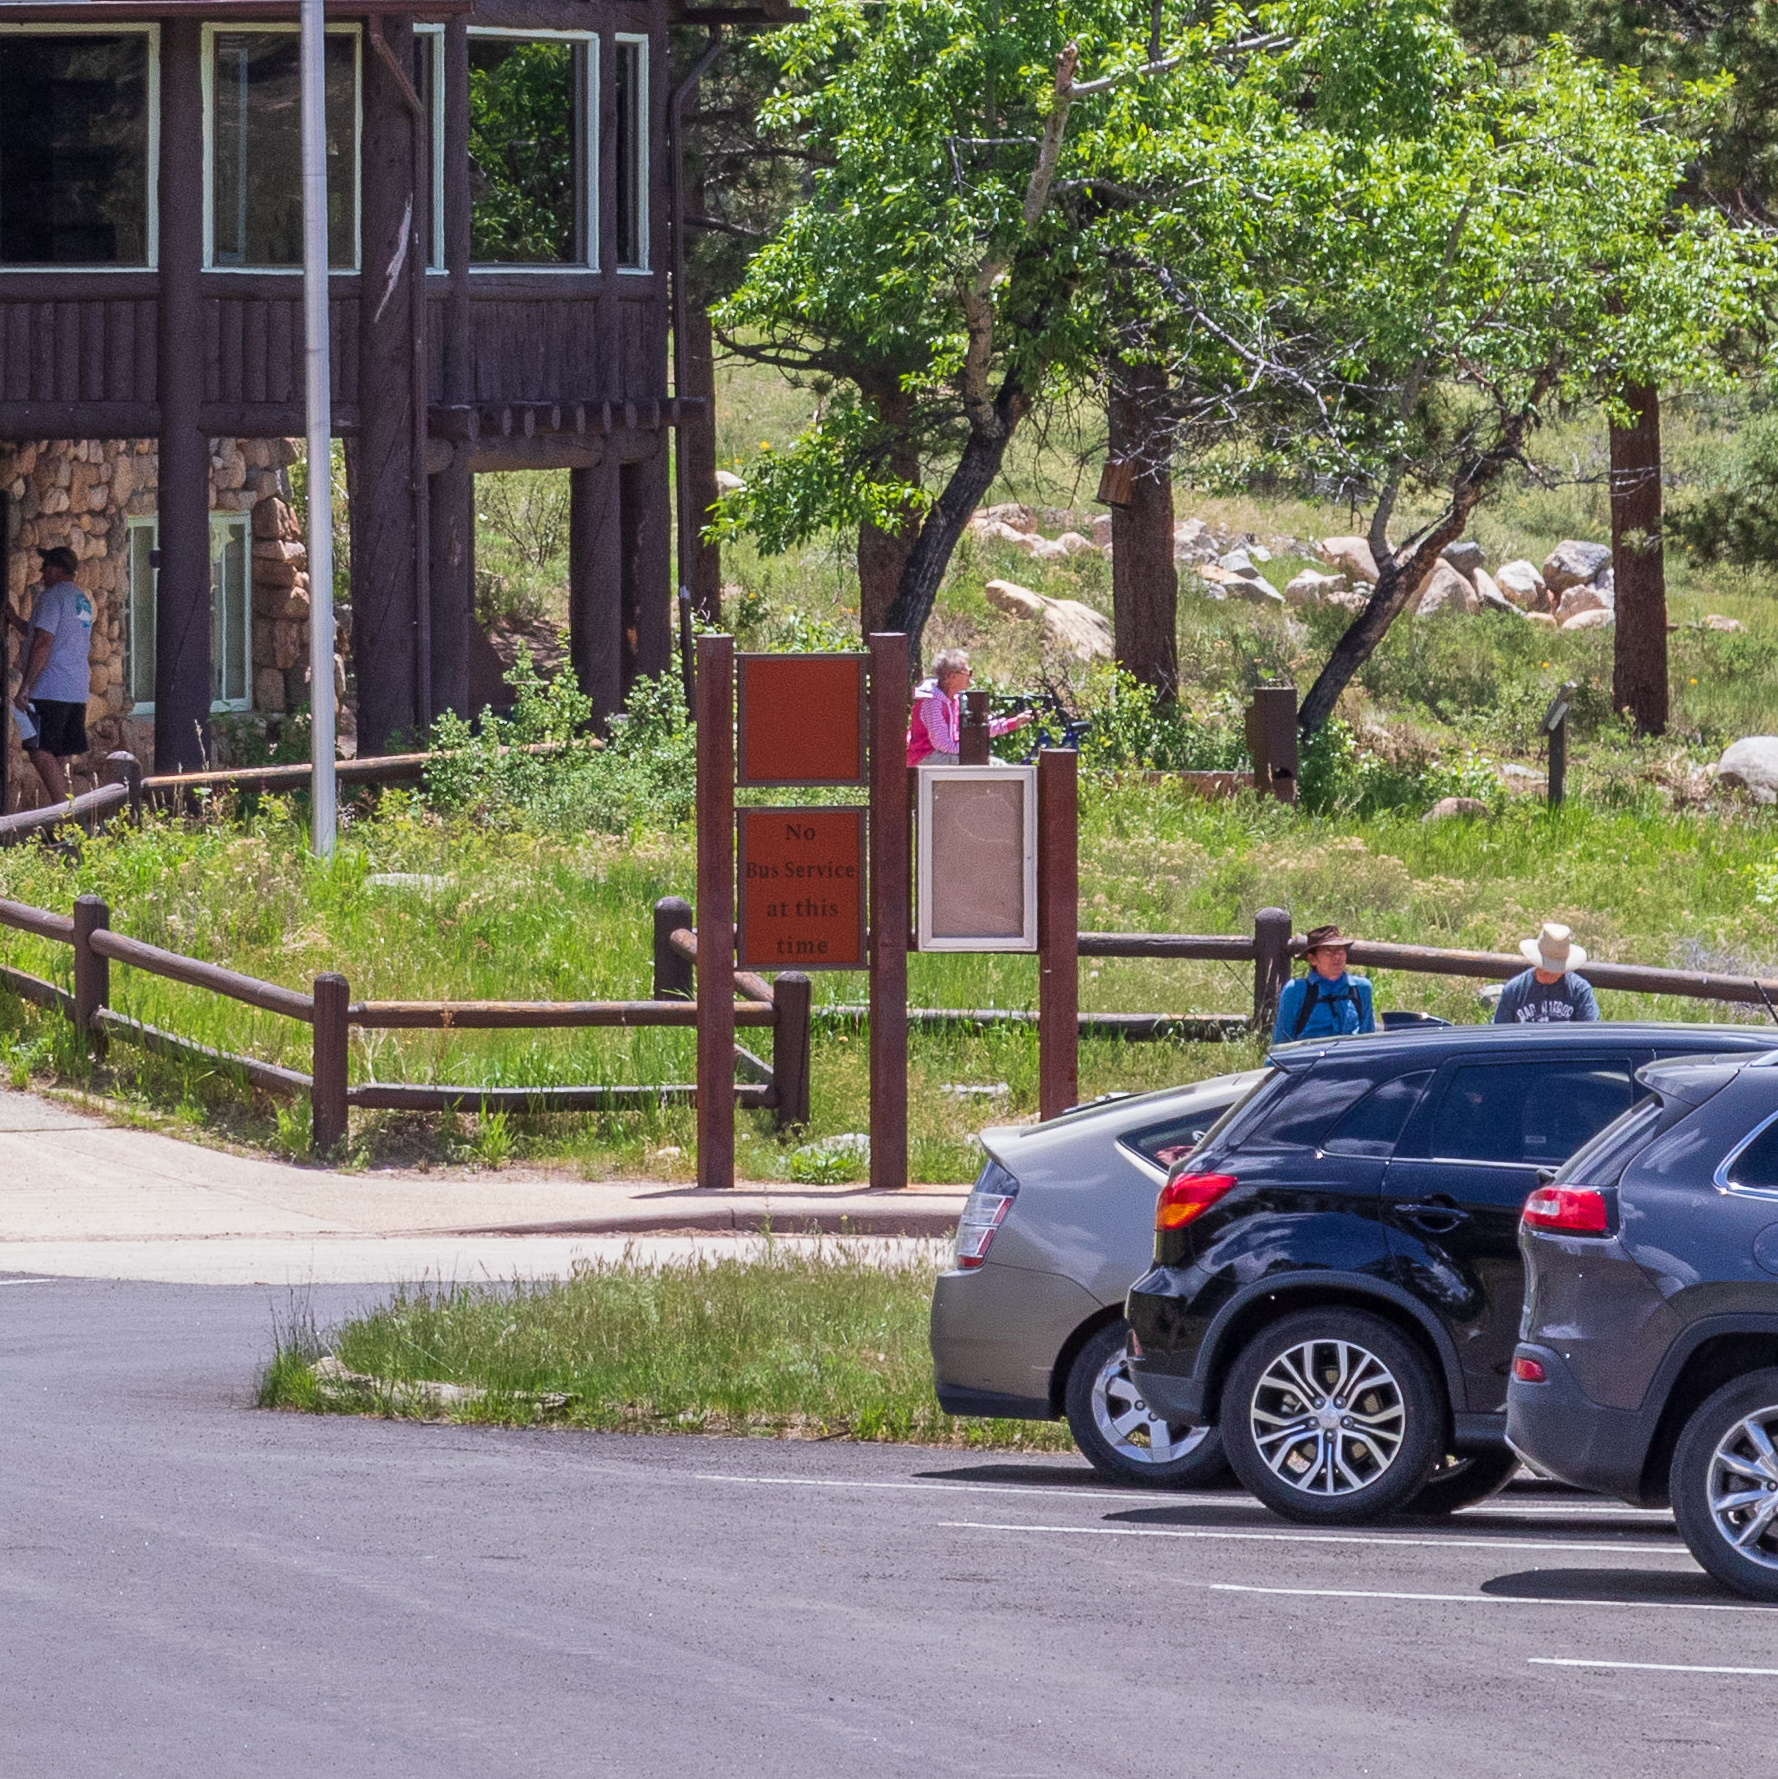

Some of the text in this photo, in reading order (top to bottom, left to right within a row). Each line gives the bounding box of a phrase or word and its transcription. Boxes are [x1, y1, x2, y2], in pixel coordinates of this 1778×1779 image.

[785, 824, 816, 841] No
[747, 860, 854, 879] Bus Service
[766, 898, 839, 918] at this
[776, 936, 829, 954] time
